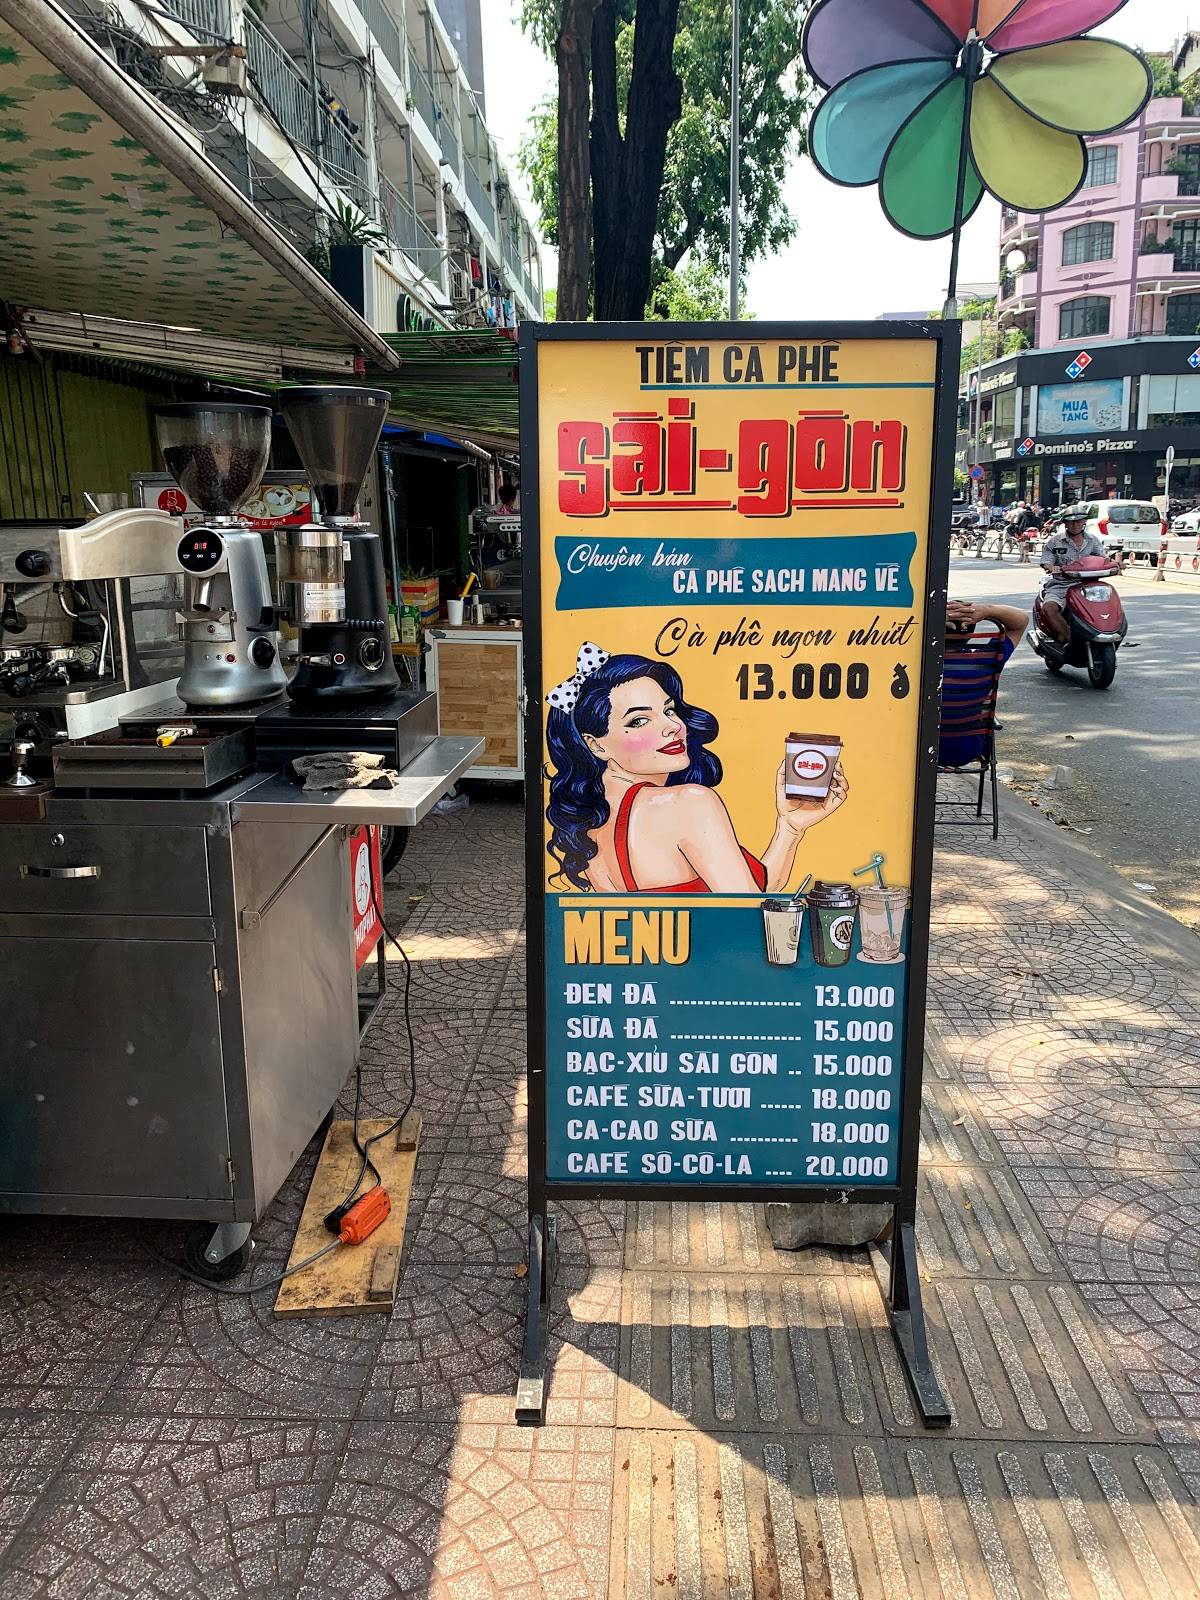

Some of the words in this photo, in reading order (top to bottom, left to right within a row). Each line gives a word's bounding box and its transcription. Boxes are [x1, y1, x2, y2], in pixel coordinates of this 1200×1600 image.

[778, 339, 842, 382] PHÊ
[1062, 400, 1088, 412] MUA
[1034, 441, 1094, 455] Domino's
[1097, 438, 1135, 452] Pizza
[567, 543, 645, 574] Chuyên
[651, 542, 694, 567] bán
[706, 566, 745, 593] PHÊ
[812, 567, 867, 592] MANG
[655, 617, 707, 656] Cà
[713, 616, 764, 655] phê
[772, 628, 837, 659] ngon
[736, 662, 869, 700] 13.000
[563, 910, 692, 966] MENU
[563, 983, 612, 1005] ĐEN
[814, 985, 895, 1008] 13.000
[813, 1020, 893, 1042] 15.000
[813, 1054, 892, 1077] 15.000
[811, 1088, 891, 1111] 18.000
[567, 1119, 659, 1141] CA-CAO
[810, 1122, 890, 1144] 18.000
[641, 1150, 753, 1175] SÔ-CÔ-LA
[805, 1155, 889, 1177] 20.000
